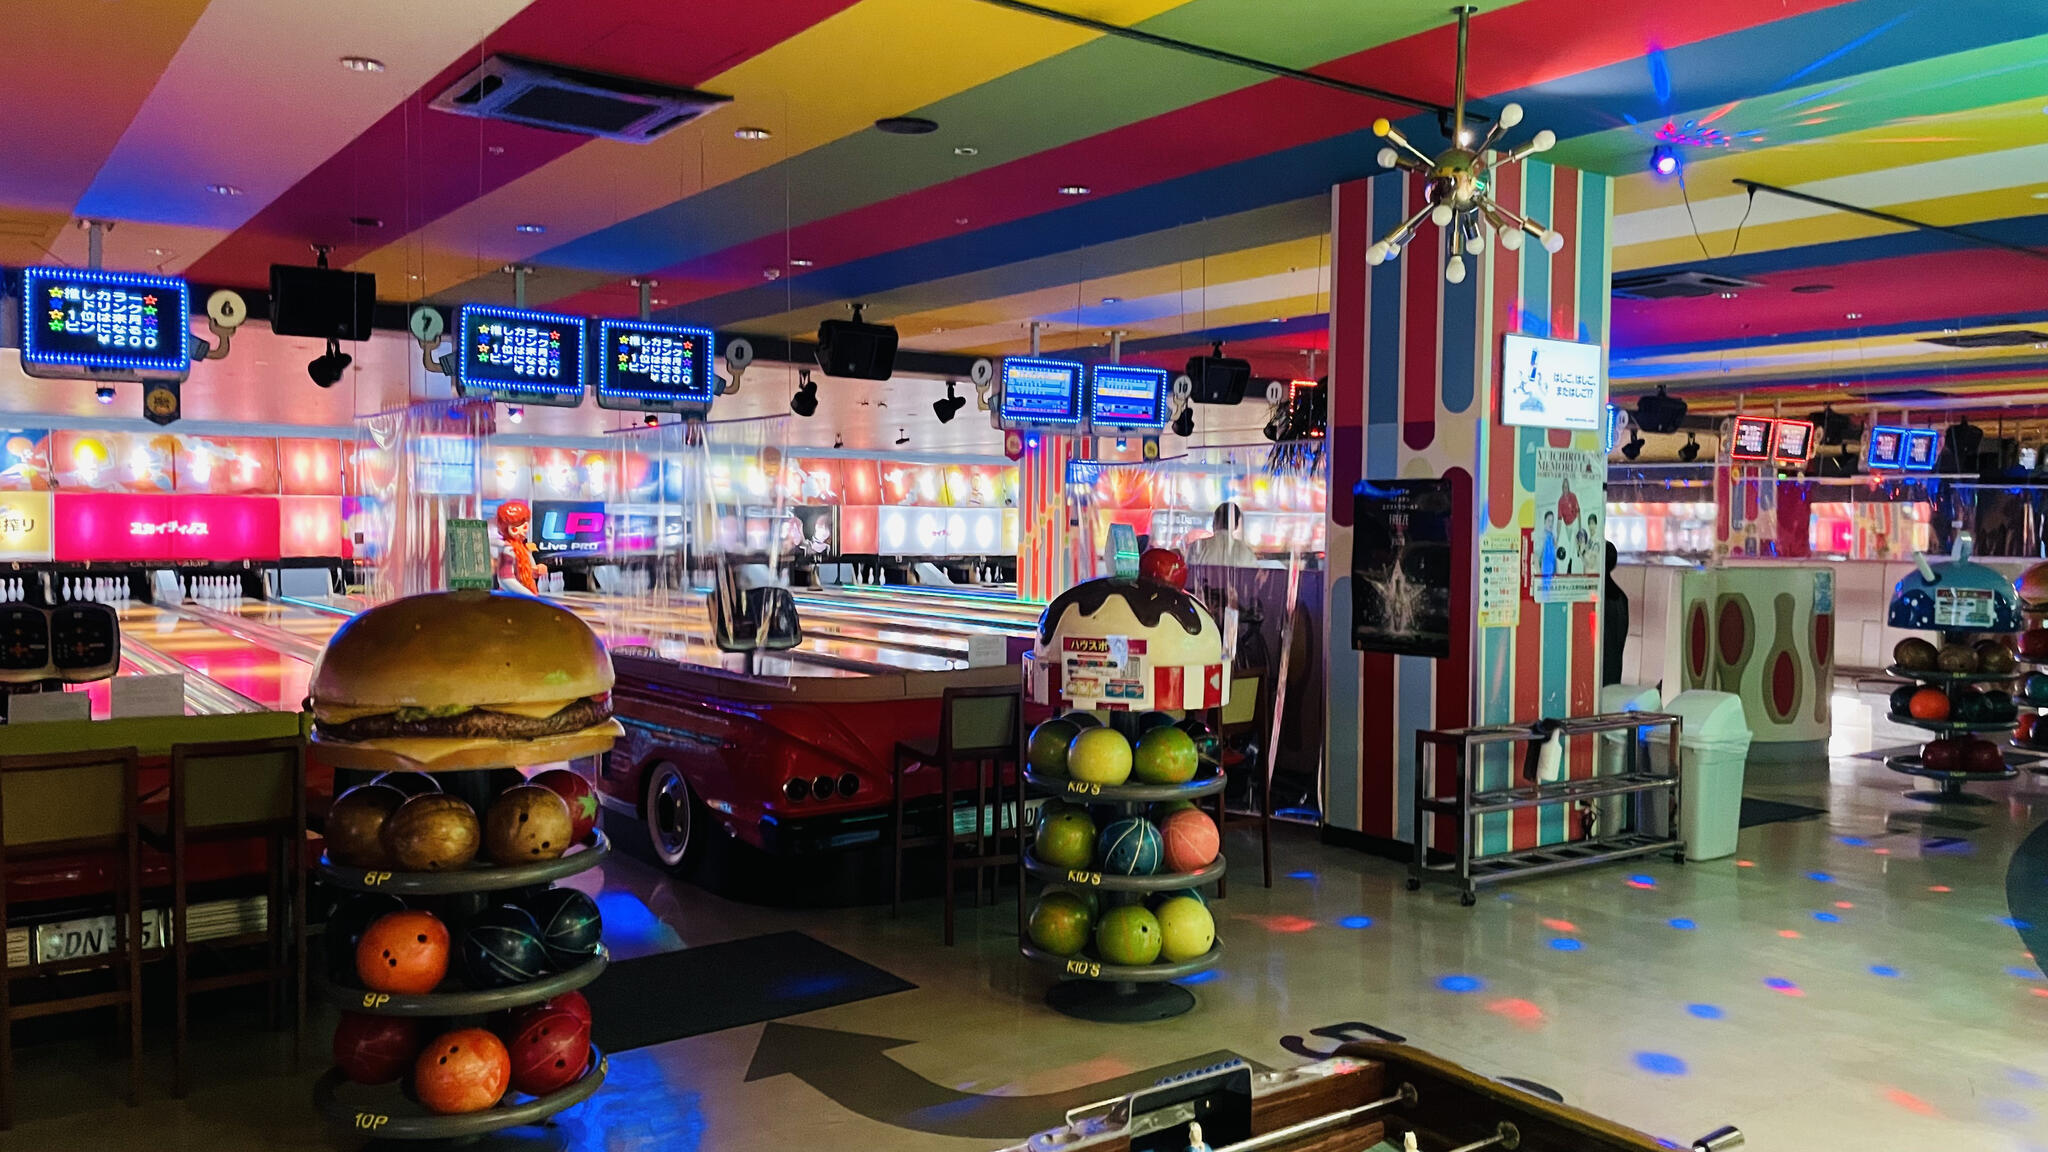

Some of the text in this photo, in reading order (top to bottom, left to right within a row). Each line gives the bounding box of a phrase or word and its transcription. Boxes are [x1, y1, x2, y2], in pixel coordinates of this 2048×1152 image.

[83, 300, 142, 314] ドリンク
[220, 300, 234, 317] 6
[421, 315, 433, 332] 7
[977, 365, 986, 379] 9
[1178, 381, 1189, 394] 10
[1270, 387, 1279, 399] 11
[542, 511, 605, 540] LP
[539, 542, 568, 551] Live
[1067, 781, 1101, 796] KID'S
[1067, 870, 1102, 886] KID'S
[1066, 959, 1101, 977] KID'S
[362, 991, 391, 1008] 9P
[355, 1111, 389, 1130] 10P
